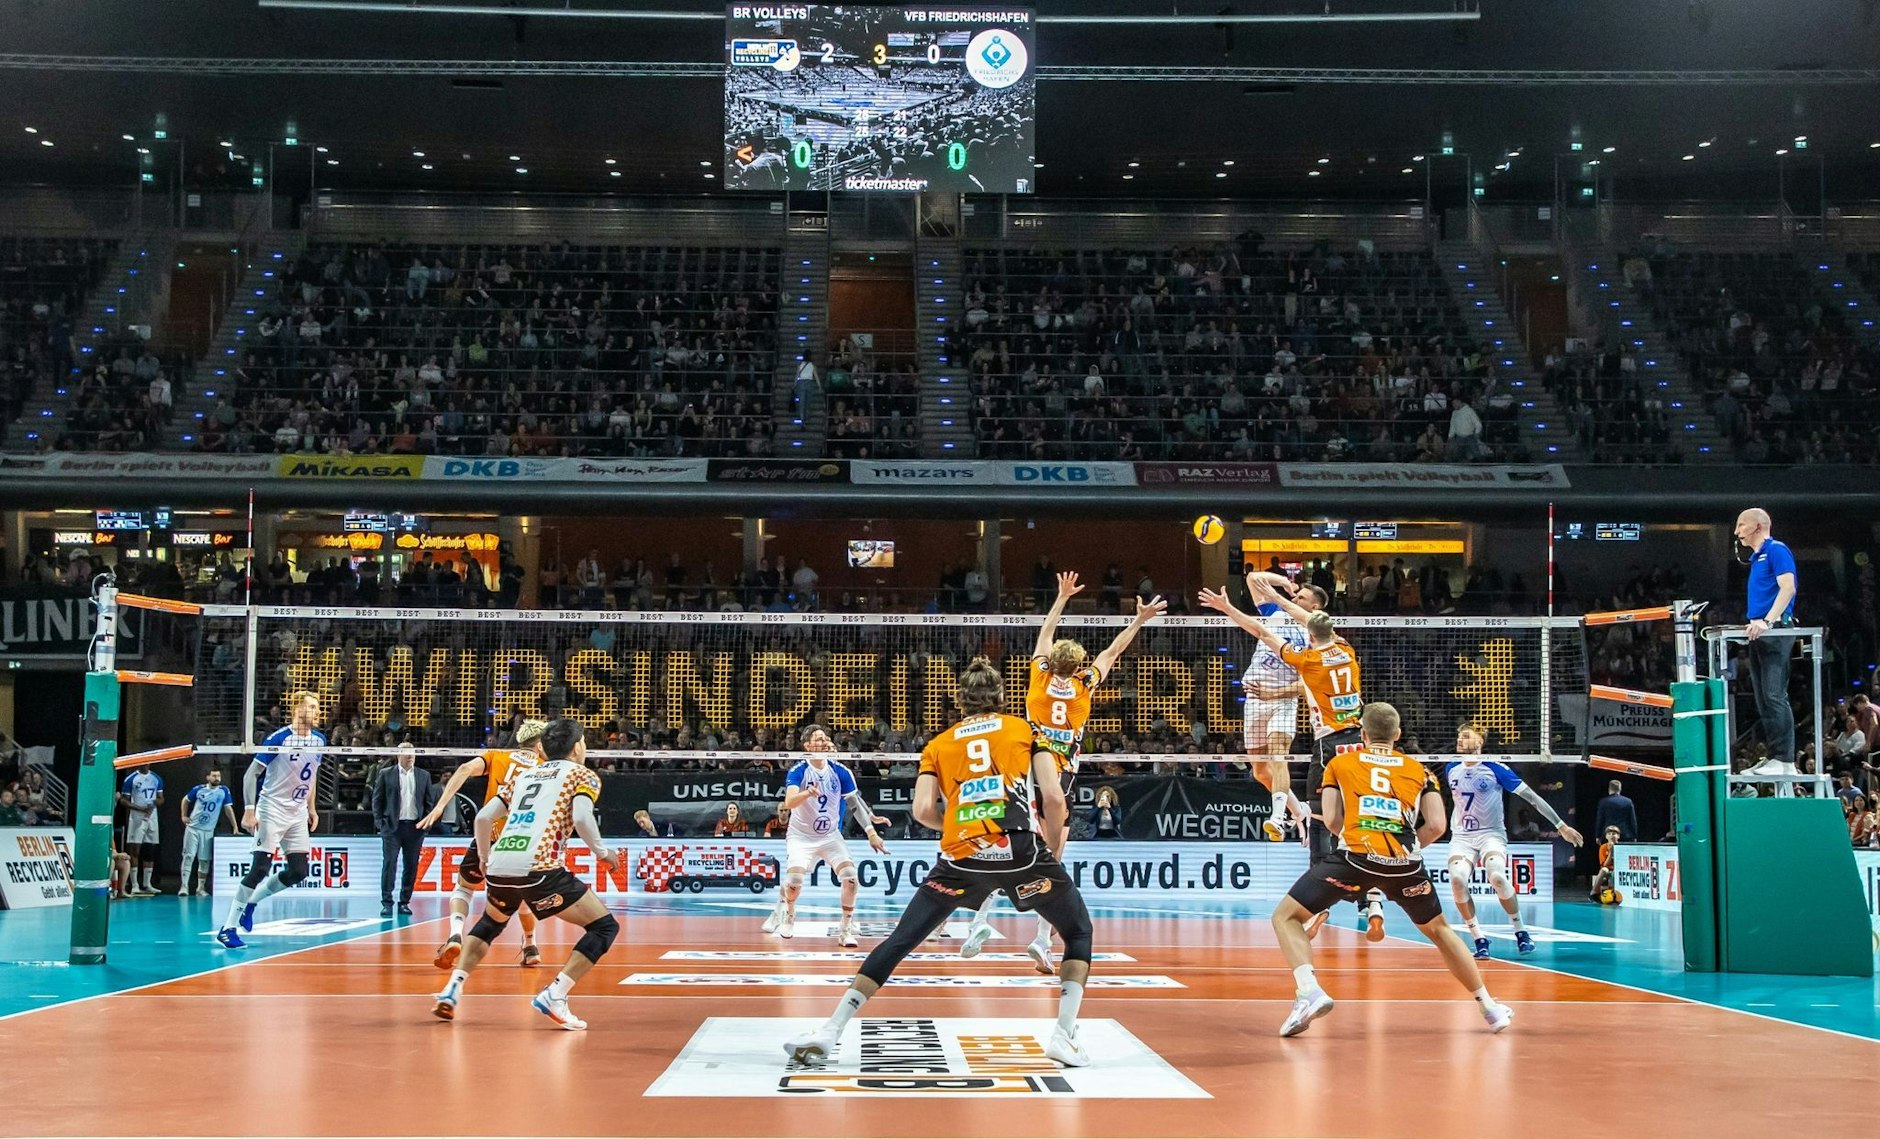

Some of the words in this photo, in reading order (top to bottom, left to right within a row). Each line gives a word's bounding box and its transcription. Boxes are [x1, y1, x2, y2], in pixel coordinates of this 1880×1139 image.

[733, 8, 751, 19] BR
[753, 8, 807, 20] VOLLEYS
[905, 11, 927, 22] VFB
[930, 12, 1029, 23] FRIEDRICHSHAFEN
[821, 43, 834, 63] 2
[874, 44, 887, 64] 3
[927, 44, 940, 64] 0
[893, 126, 907, 138] 22
[794, 141, 811, 169] 0
[949, 142, 966, 170] 0
[845, 176, 923, 191] ticketmaster
[60, 460, 115, 471] Berlin
[178, 461, 271, 475] Volleyball
[444, 461, 520, 477] DKB
[872, 468, 975, 479] mazars
[1014, 466, 1089, 482] DKB
[1178, 468, 1215, 477] RAZ
[1215, 468, 1270, 479] Verlag
[1290, 470, 1344, 481] Berlin
[1347, 470, 1400, 483] spielt
[1402, 471, 1495, 483] Volleyball
[54, 532, 93, 544] NESCAFÉ
[95, 532, 115, 544] Bar
[173, 533, 211, 545] NESCAFÉ
[214, 534, 233, 545] Bar
[1364, 618, 1388, 626] BEST
[1404, 618, 1428, 626] BEST
[1445, 618, 1468, 626] BEST
[1485, 618, 1508, 626] BEST
[1329, 667, 1352, 694] 17
[1051, 701, 1068, 726] 8
[1593, 715, 1674, 728] MÜNCHHAGE
[959, 722, 997, 735] mazars
[1044, 728, 1071, 742] DKB
[1050, 742, 1068, 753] IGO
[966, 739, 992, 773] 9
[300, 762, 312, 781] 6
[962, 778, 1000, 797] DKB
[1370, 766, 1391, 794] 6
[141, 788, 156, 799] 17
[518, 783, 542, 811] 2
[673, 782, 786, 799] UNSCHLA
[201, 801, 217, 813] 10
[818, 794, 828, 810] 9
[1205, 803, 1272, 814] AUTOHAU
[1363, 797, 1398, 811] DKB
[1461, 792, 1475, 812] 7
[959, 805, 1001, 822] LIGO
[816, 819, 830, 832] ZF
[1155, 813, 1302, 841] WEGEN
[16, 836, 57, 857] BERLIN
[970, 849, 1012, 860] ecuritas
[1368, 853, 1408, 865] Securitas
[1628, 855, 1650, 871] BERLIN
[5, 860, 65, 884] RECYCLING
[1619, 871, 1650, 888] RECYCLING
[1468, 886, 1481, 895] ebt
[860, 1019, 951, 1074] RECYCLING
